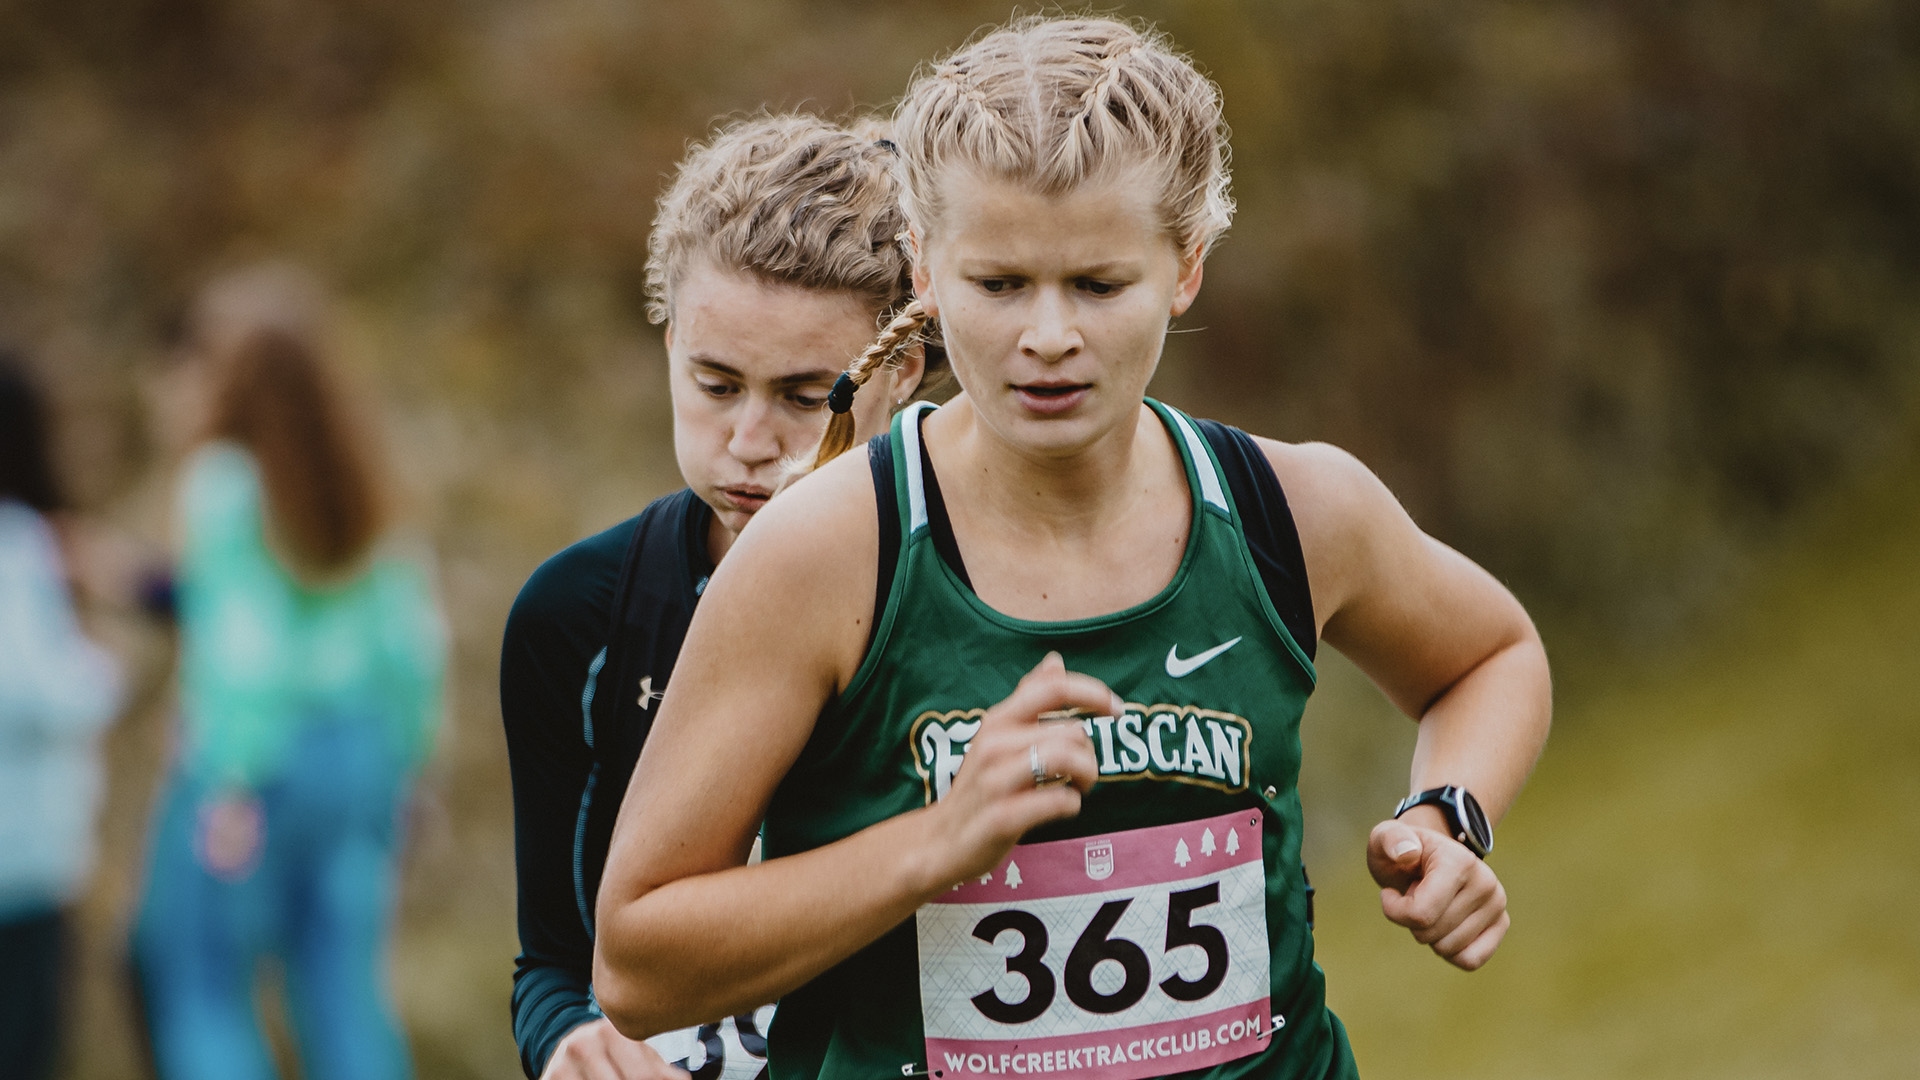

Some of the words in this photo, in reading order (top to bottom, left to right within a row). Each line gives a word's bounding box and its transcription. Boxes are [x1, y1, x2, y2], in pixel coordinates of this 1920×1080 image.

[921, 712, 1243, 803] FISCAN
[970, 881, 1229, 1024] 365
[943, 1014, 1261, 1075] WOLFCREEKTRACKCLUB.COM
